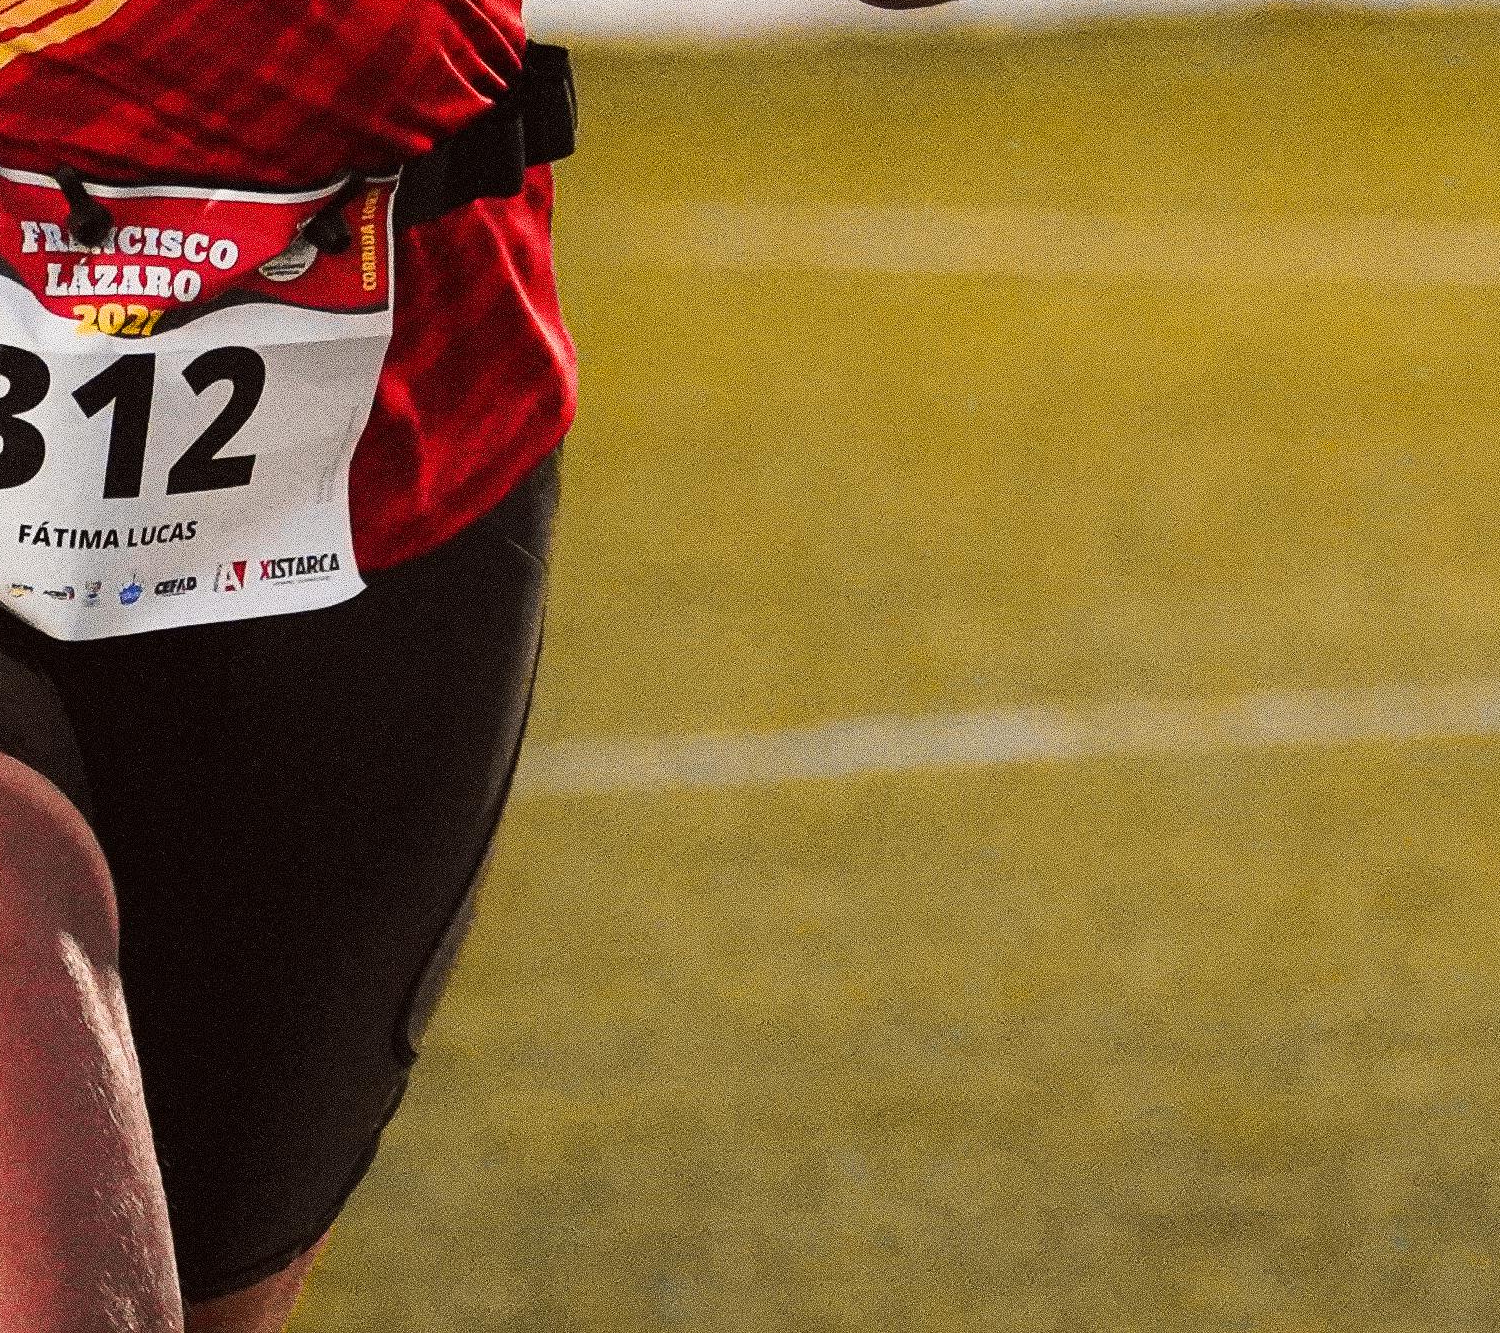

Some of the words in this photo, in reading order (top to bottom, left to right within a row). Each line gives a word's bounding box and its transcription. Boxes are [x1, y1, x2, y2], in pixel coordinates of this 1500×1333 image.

[20, 220, 239, 271] FRCISCO
[361, 225, 377, 291] CORRIDA
[45, 258, 202, 303] LÁZARO
[72, 302, 164, 336] 2021
[18, 520, 120, 551] FÁTIMA
[127, 520, 198, 548] LUCAS
[259, 552, 339, 581] XISTARCA
